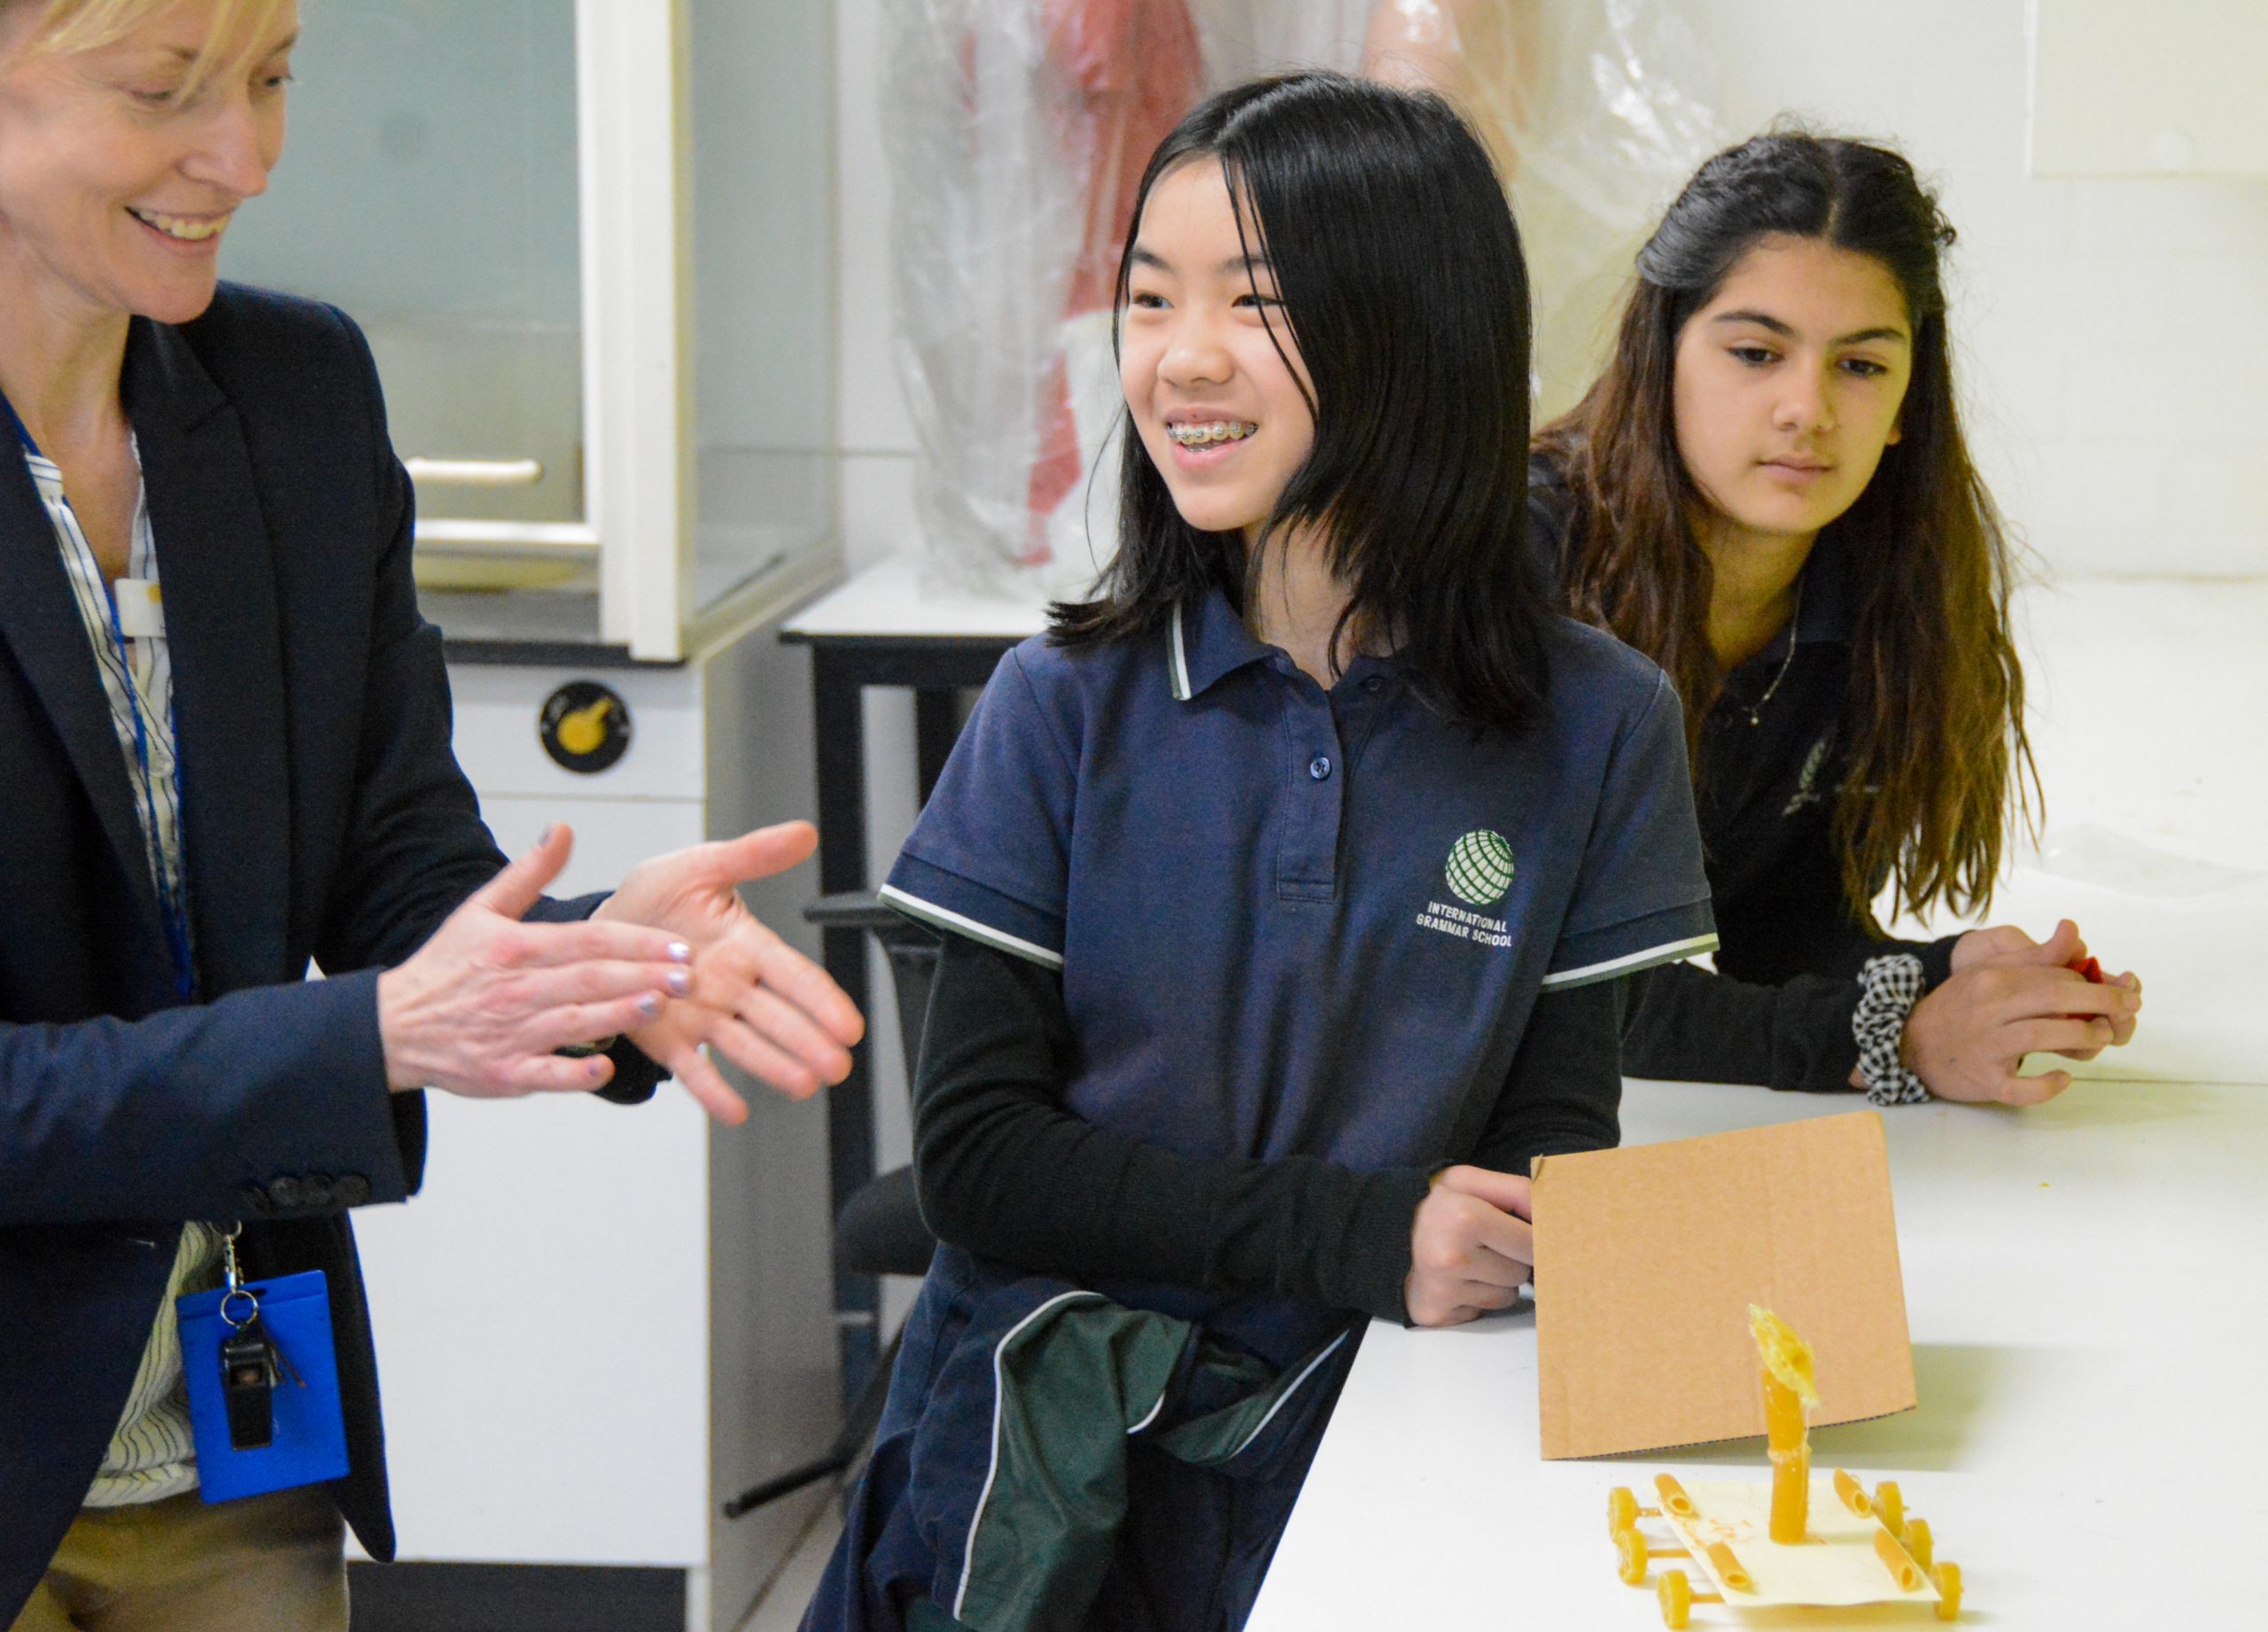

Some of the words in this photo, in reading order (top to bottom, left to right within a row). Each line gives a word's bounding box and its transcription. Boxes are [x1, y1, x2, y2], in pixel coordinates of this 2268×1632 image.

[1417, 913, 1469, 938] GRAMMAR
[1472, 929, 1511, 947] SCHOOL
[1428, 901, 1507, 932] INTERNATIONAL
